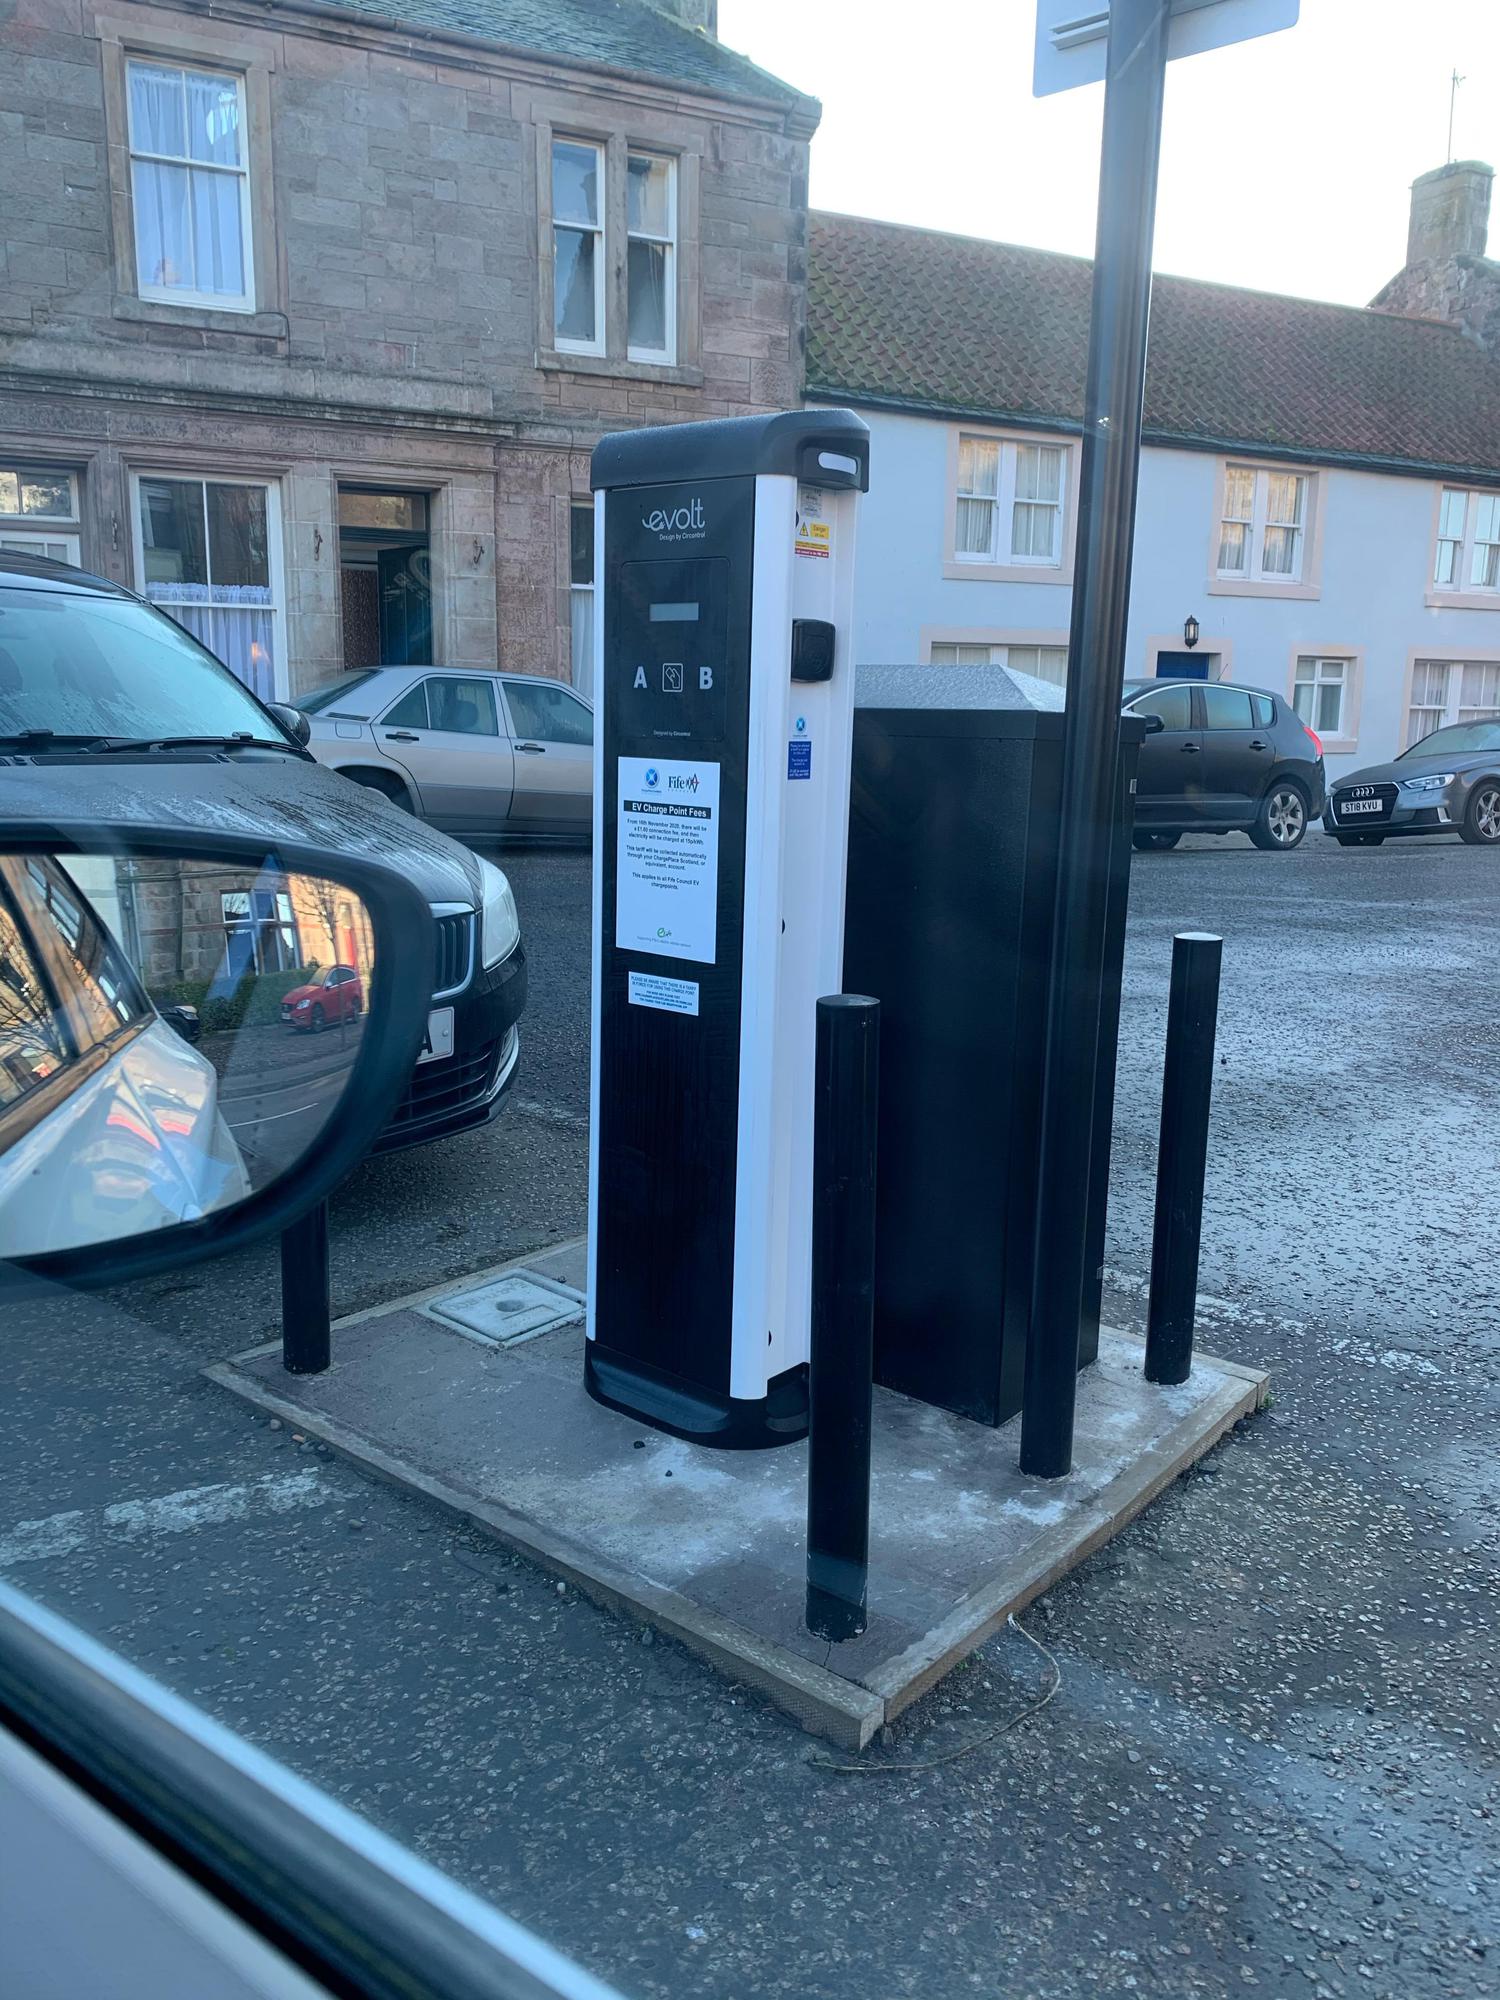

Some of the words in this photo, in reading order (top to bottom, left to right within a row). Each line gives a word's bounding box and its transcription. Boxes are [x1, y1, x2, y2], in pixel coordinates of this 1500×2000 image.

[642, 498, 705, 531] evolt
[633, 666, 647, 688] A
[699, 666, 713, 690] B
[668, 775, 685, 789] Fife
[632, 802, 642, 811] EV
[643, 804, 667, 815] Charge
[669, 806, 687, 816] Point
[689, 807, 707, 817] Fees
[1362, 801, 1377, 811] KVU
[654, 854, 679, 862] ChargePlace
[679, 852, 706, 860] automatically
